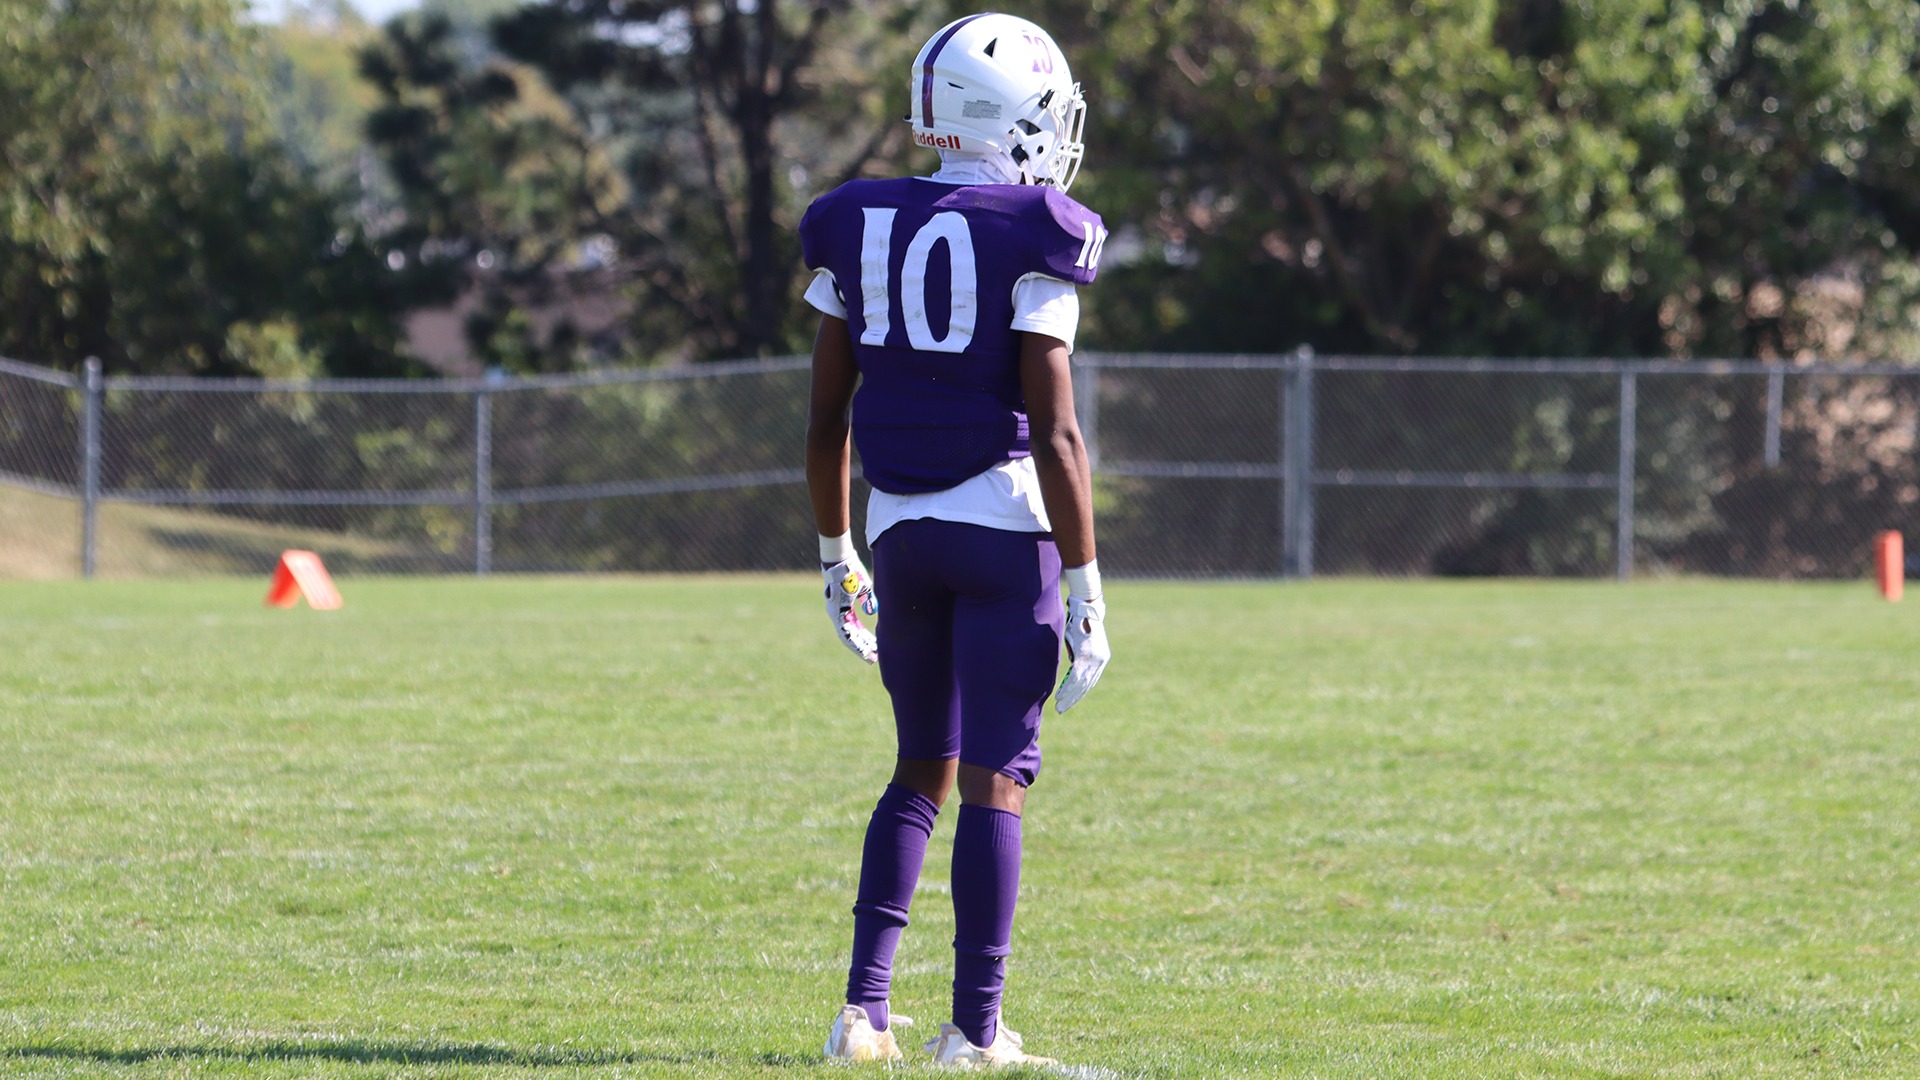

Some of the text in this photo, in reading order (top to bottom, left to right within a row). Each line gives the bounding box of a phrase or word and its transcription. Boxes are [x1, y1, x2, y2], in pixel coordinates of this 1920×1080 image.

[1022, 34, 1054, 75] 10
[1074, 221, 1106, 270] 10
[860, 207, 977, 354] 10
